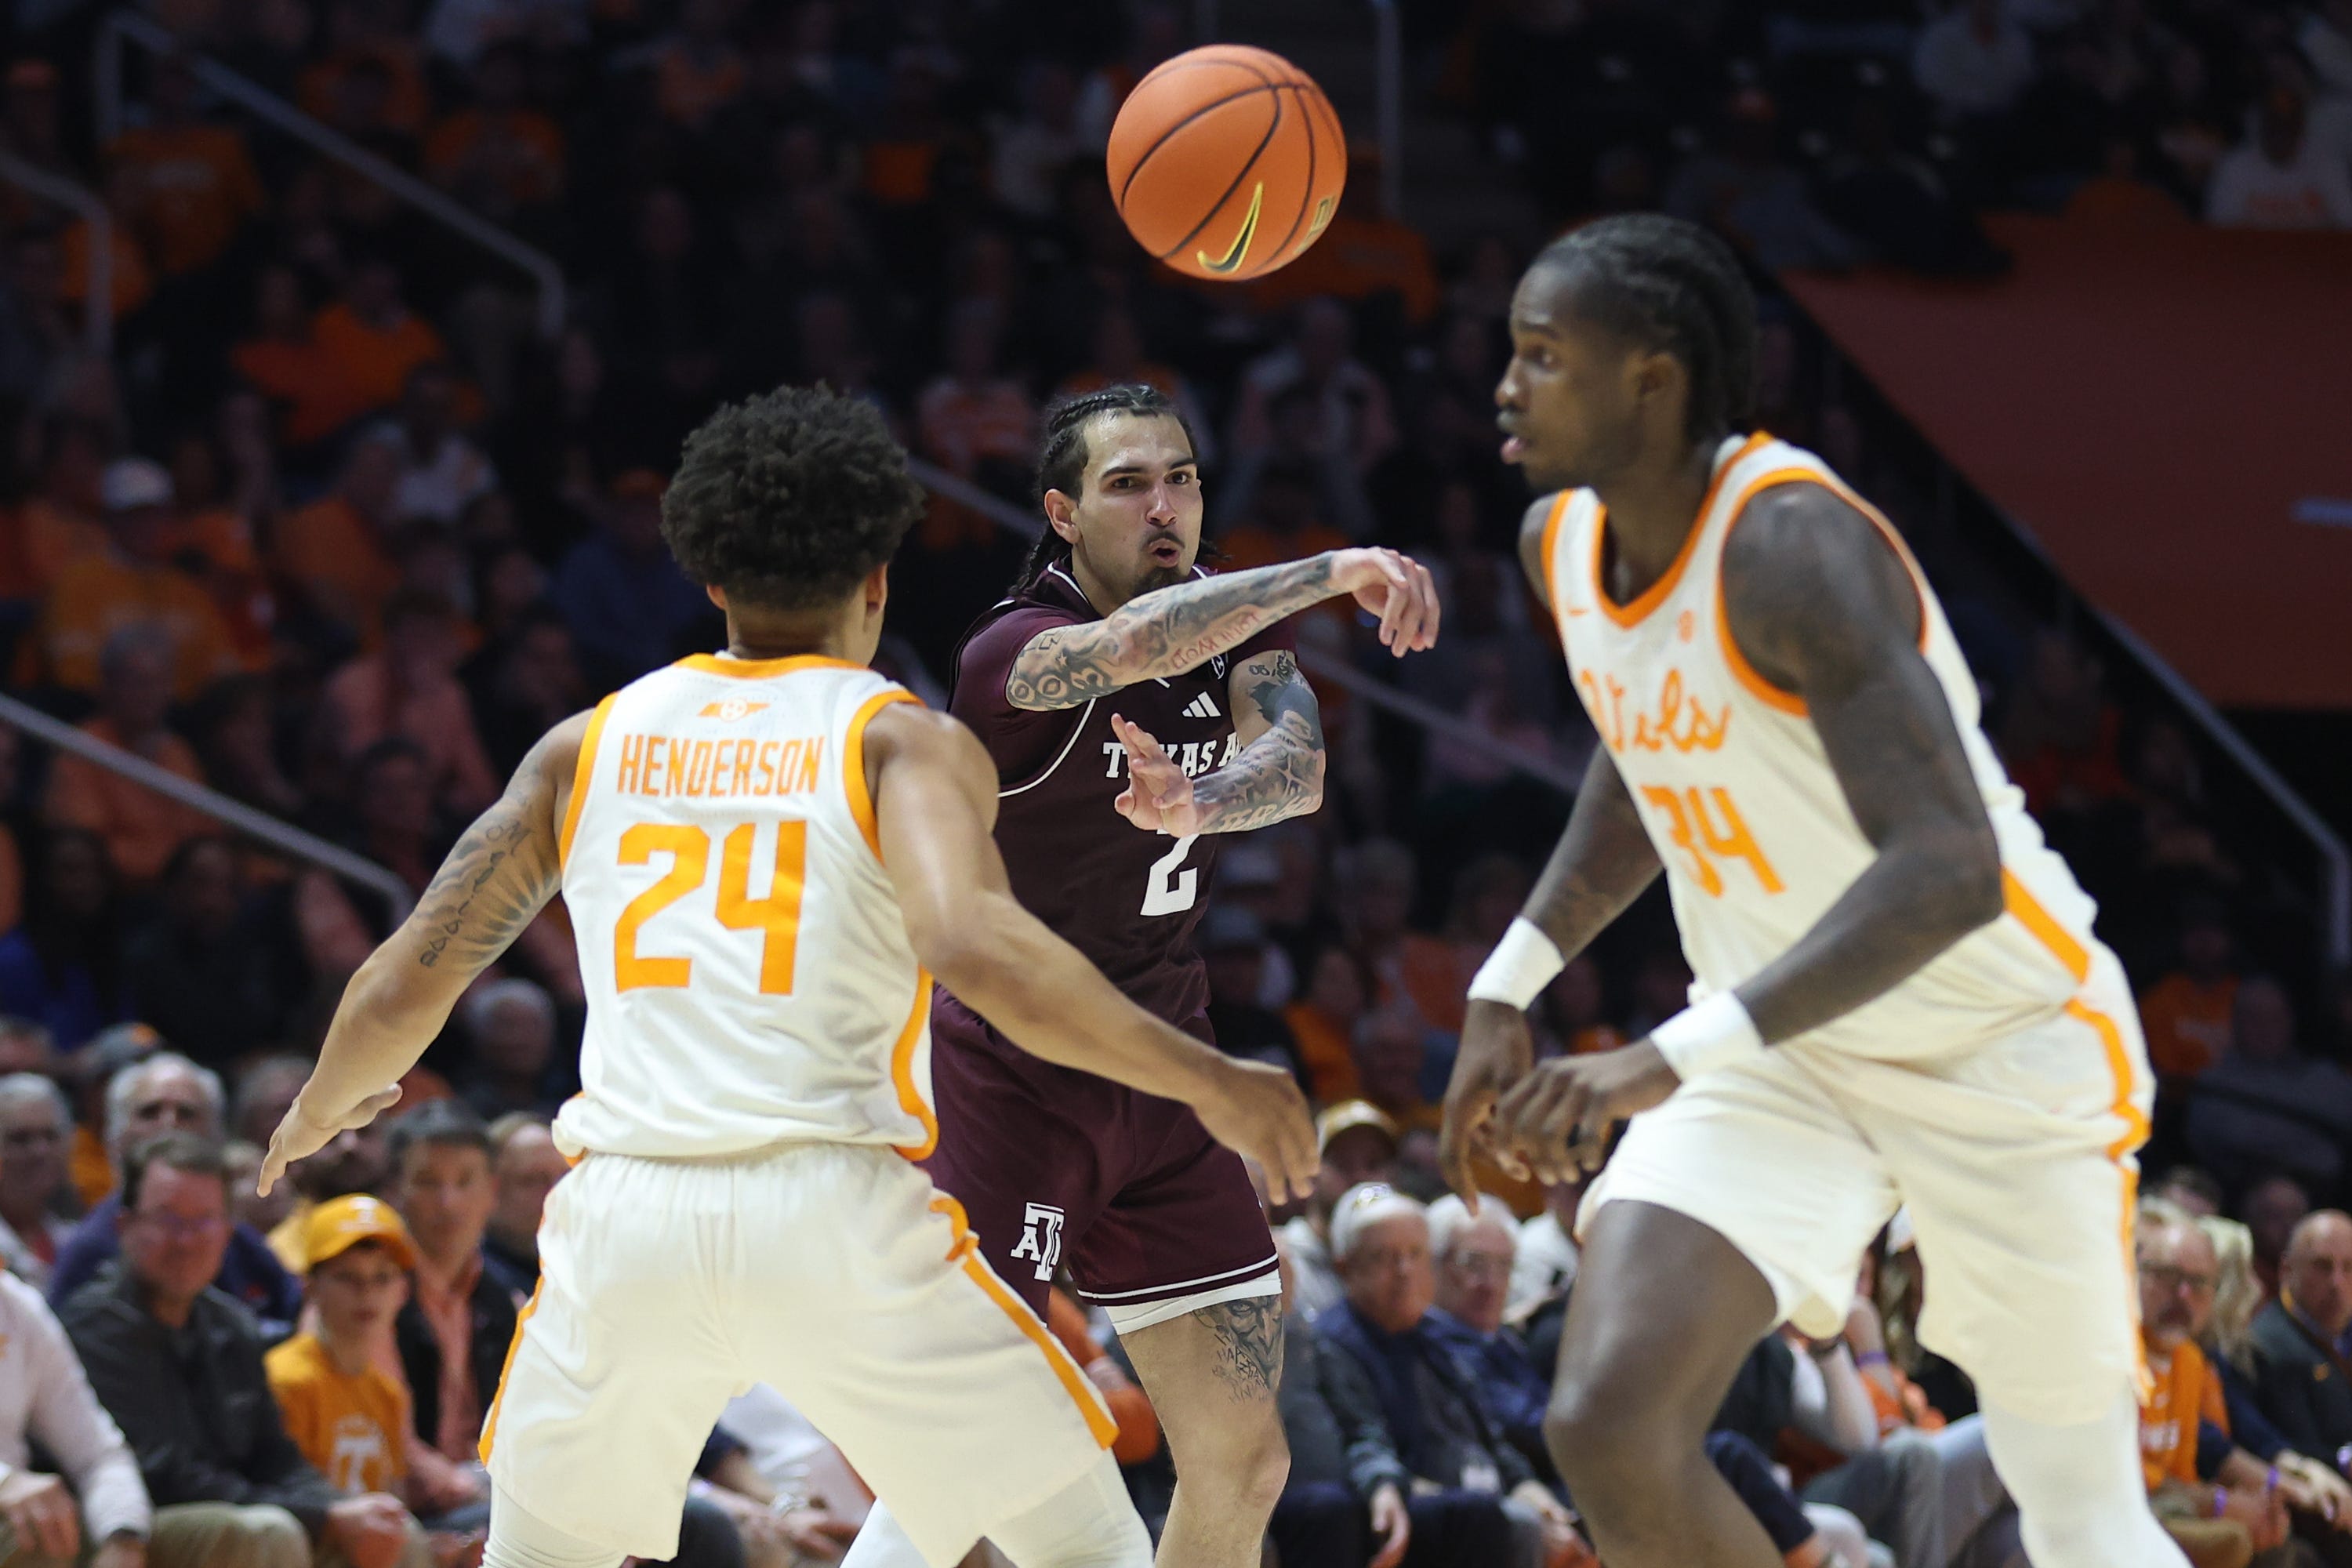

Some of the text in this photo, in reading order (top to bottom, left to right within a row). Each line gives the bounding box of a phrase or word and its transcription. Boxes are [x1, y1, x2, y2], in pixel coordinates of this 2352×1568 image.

[618, 734, 825, 797] HENDERSON
[614, 819, 807, 996] 24
[1140, 829, 1200, 916] 2
